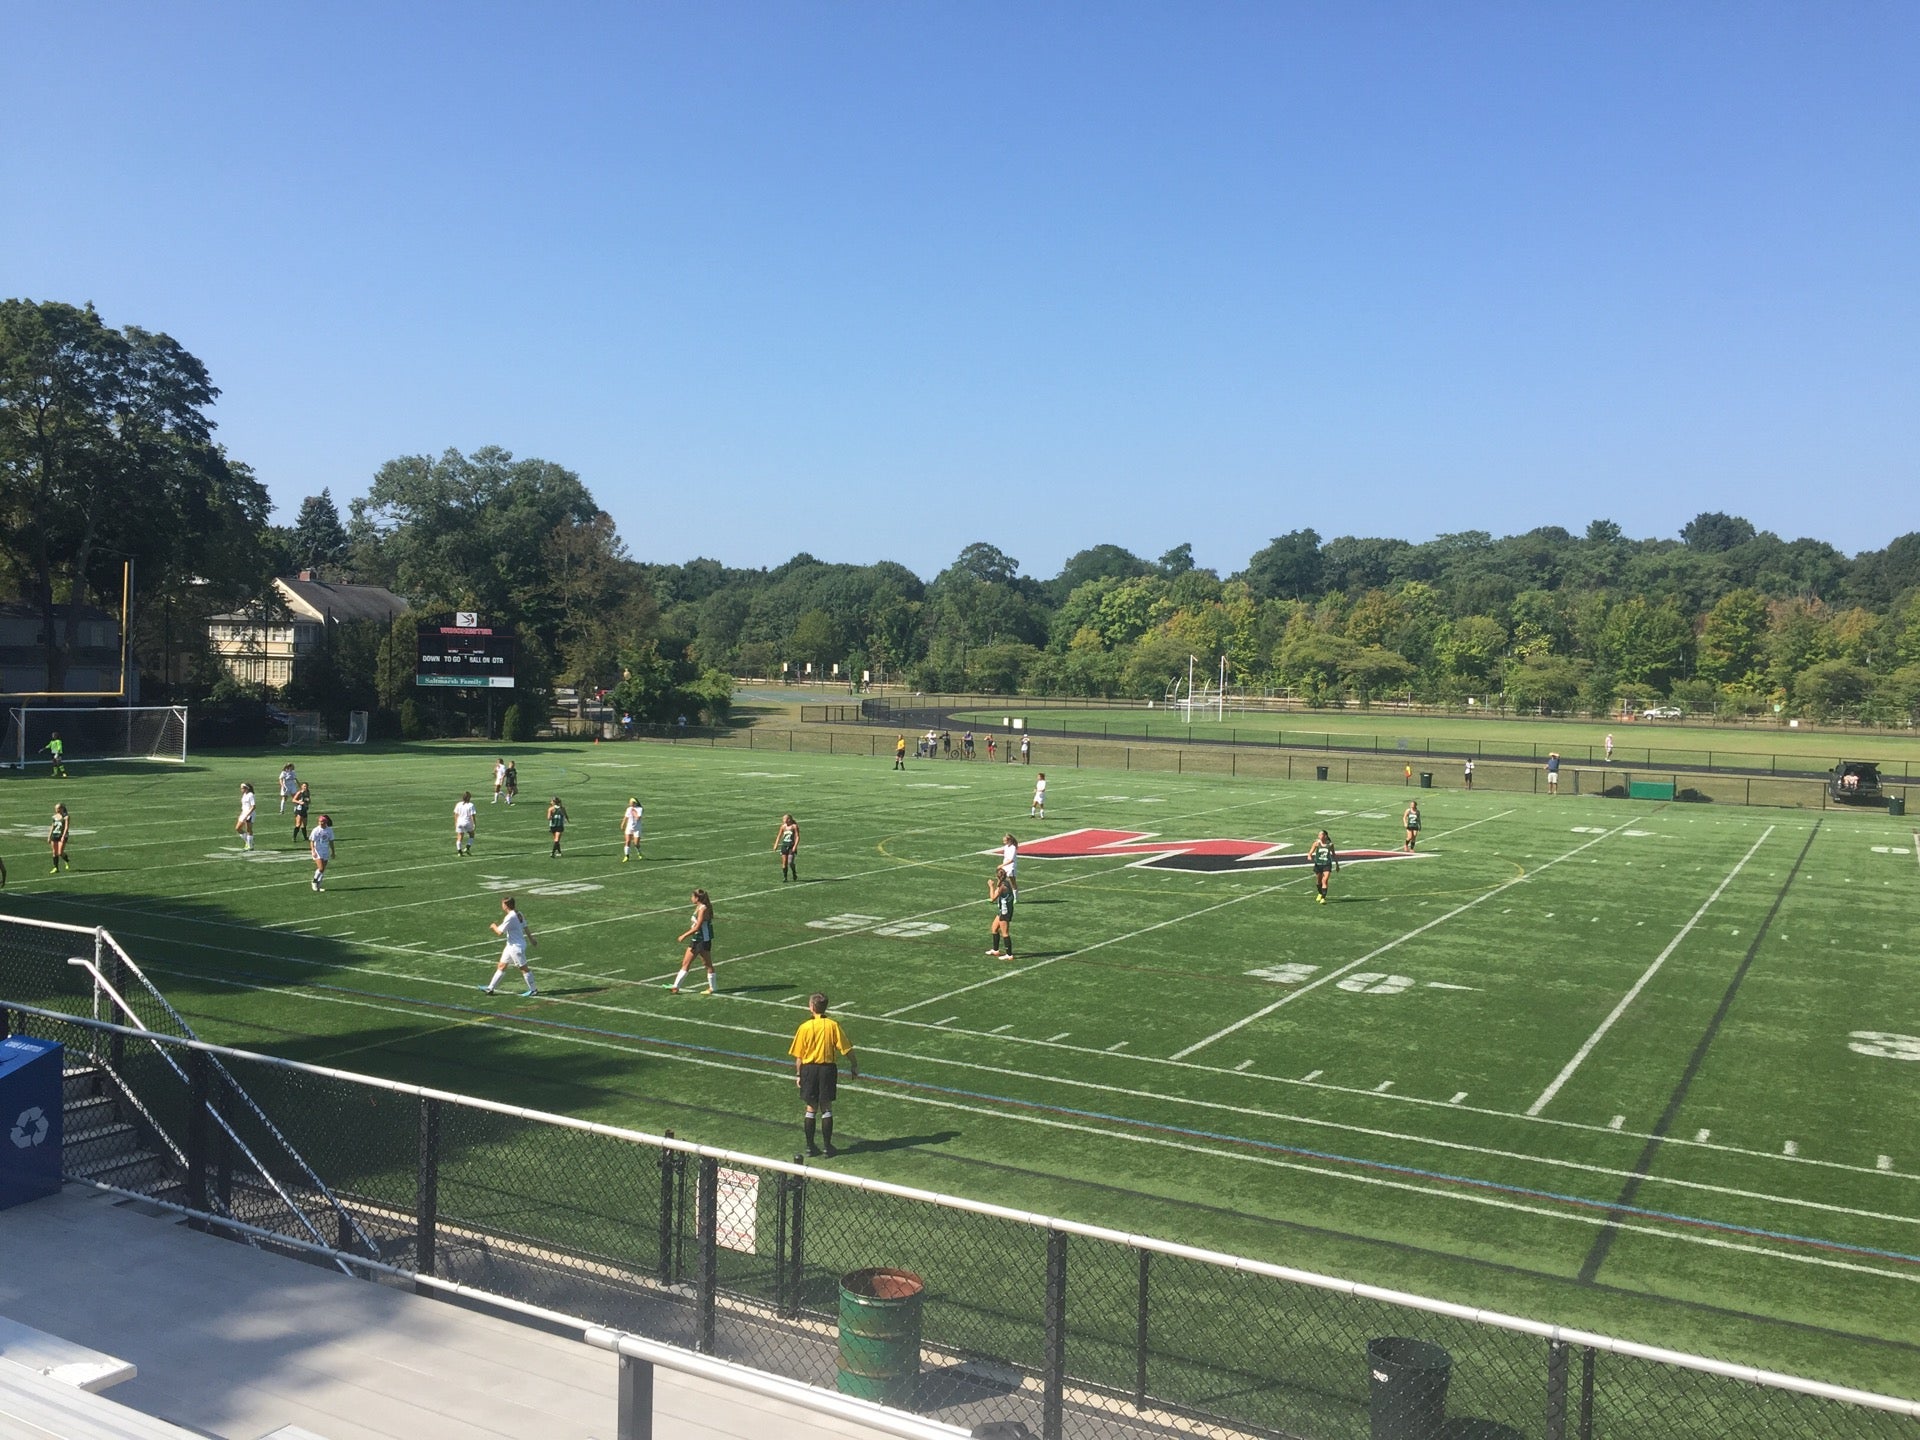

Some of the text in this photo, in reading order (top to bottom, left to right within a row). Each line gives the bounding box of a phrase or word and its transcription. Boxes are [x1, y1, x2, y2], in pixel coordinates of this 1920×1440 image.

[443, 655, 451, 663] TO
[460, 678, 482, 686] Family
[804, 913, 951, 937] 50
